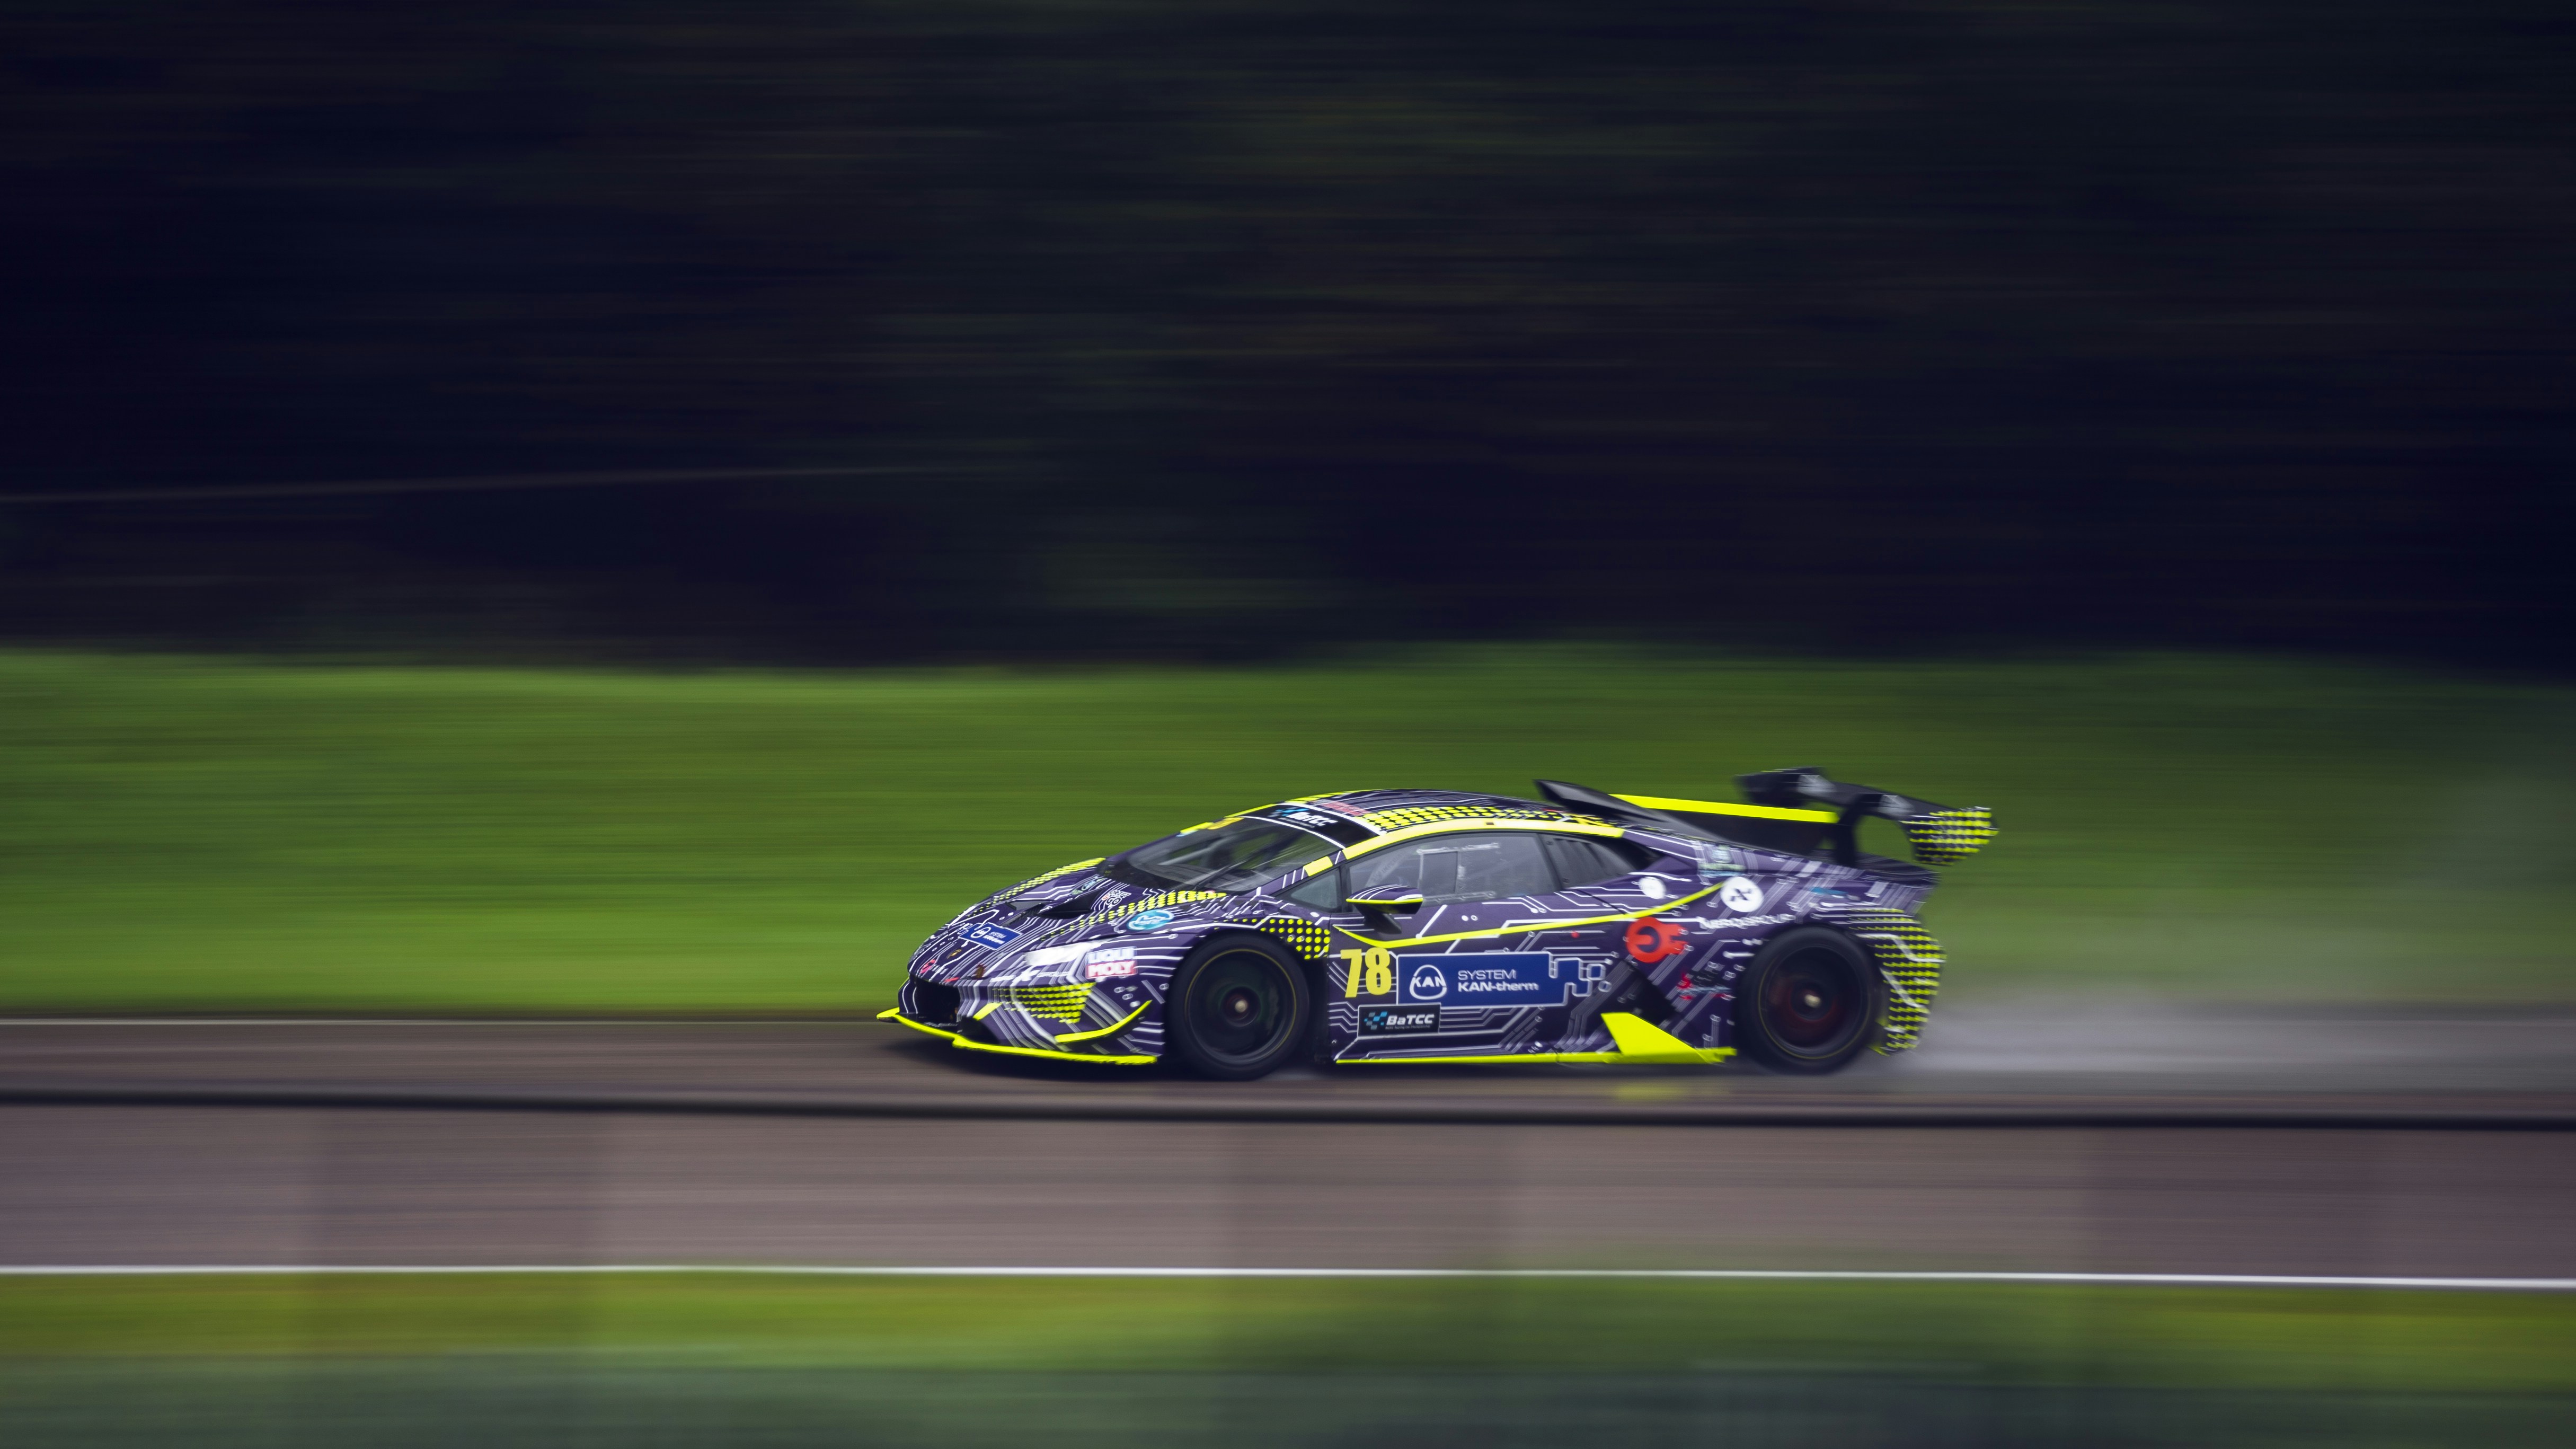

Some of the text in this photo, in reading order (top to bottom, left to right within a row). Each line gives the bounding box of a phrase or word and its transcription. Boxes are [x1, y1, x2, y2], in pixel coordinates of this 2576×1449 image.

[1088, 960, 1136, 977] MOLY
[1340, 947, 1392, 997] 78
[1457, 969, 1517, 980] SYSTEM
[1412, 976, 1446, 987] KAN
[1457, 980, 1539, 992] KAN-therm
[1386, 1013, 1435, 1026] BaTCC
